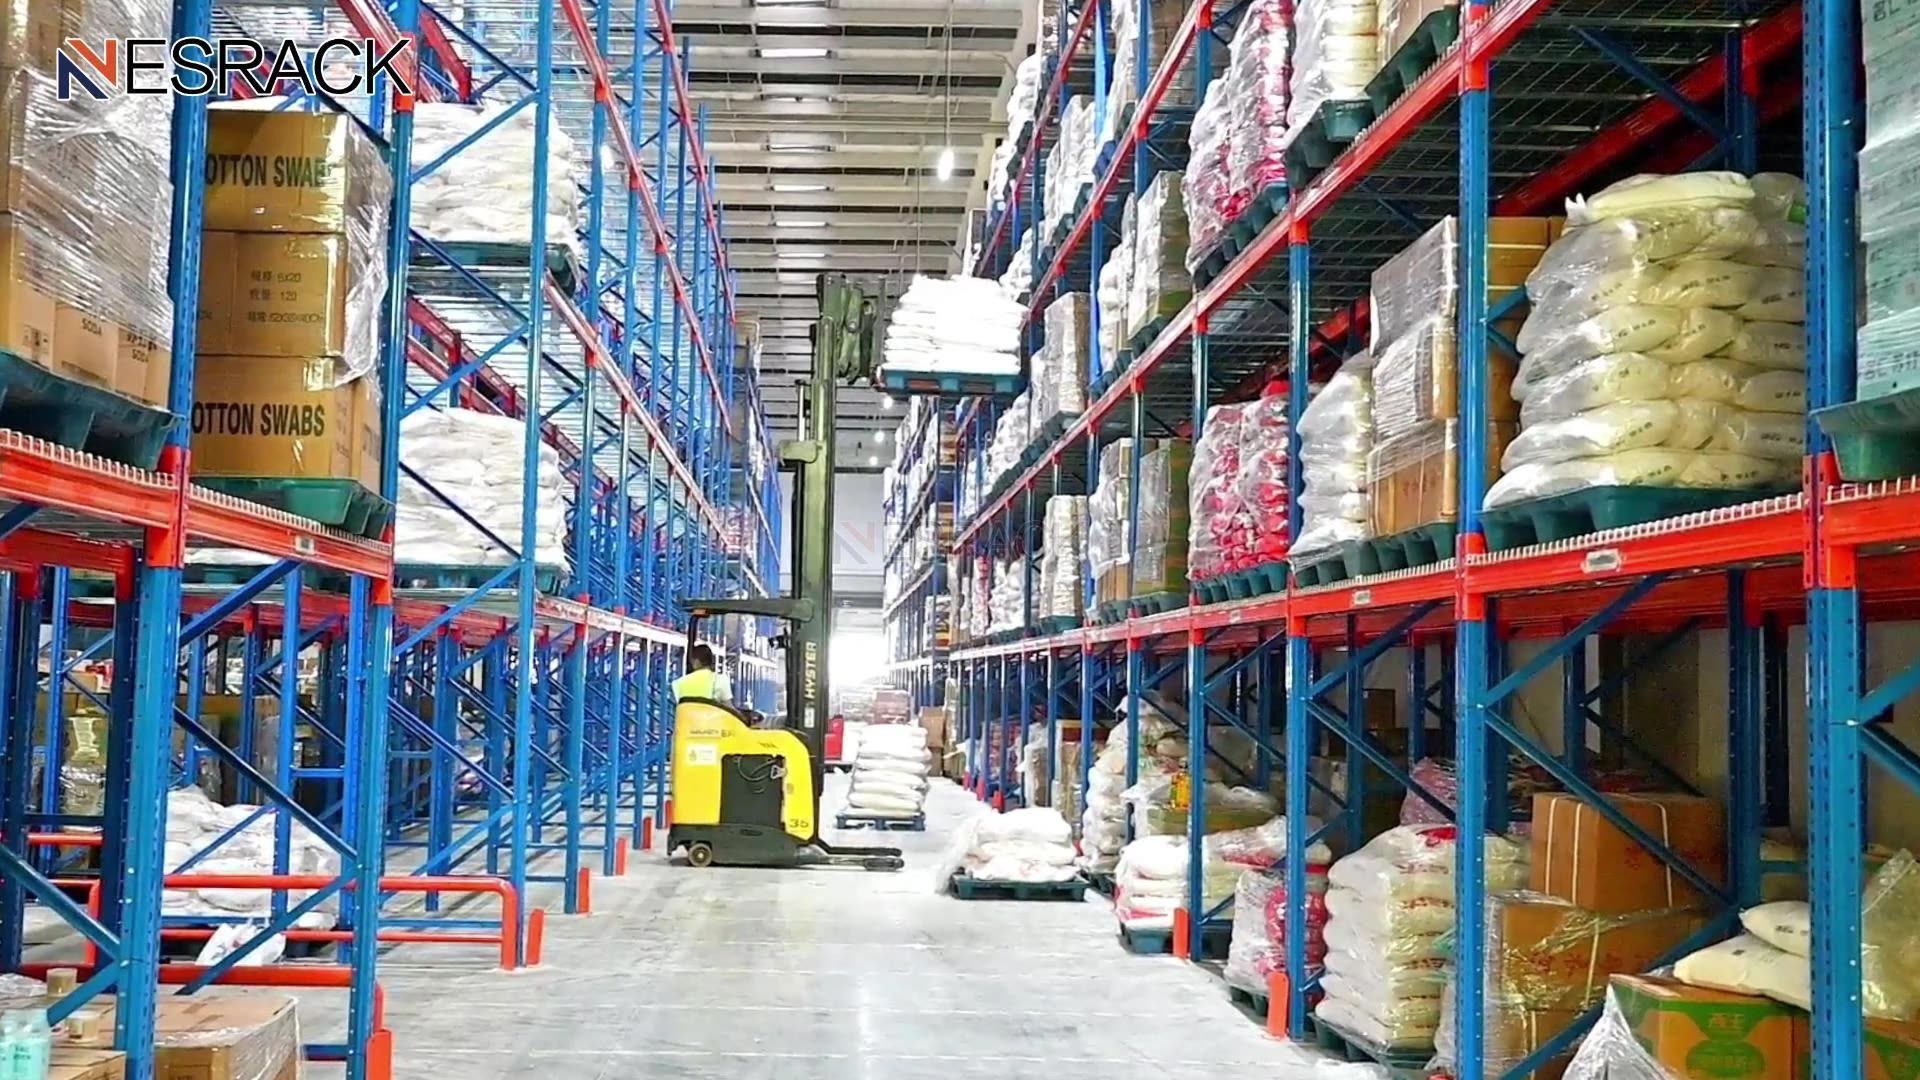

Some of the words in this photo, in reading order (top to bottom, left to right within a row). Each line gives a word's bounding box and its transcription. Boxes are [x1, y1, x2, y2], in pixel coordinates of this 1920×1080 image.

[205, 153, 267, 187] OTTON
[191, 401, 254, 436] OTTON
[260, 403, 325, 437] SWABS
[804, 640, 817, 699] HYSTER
